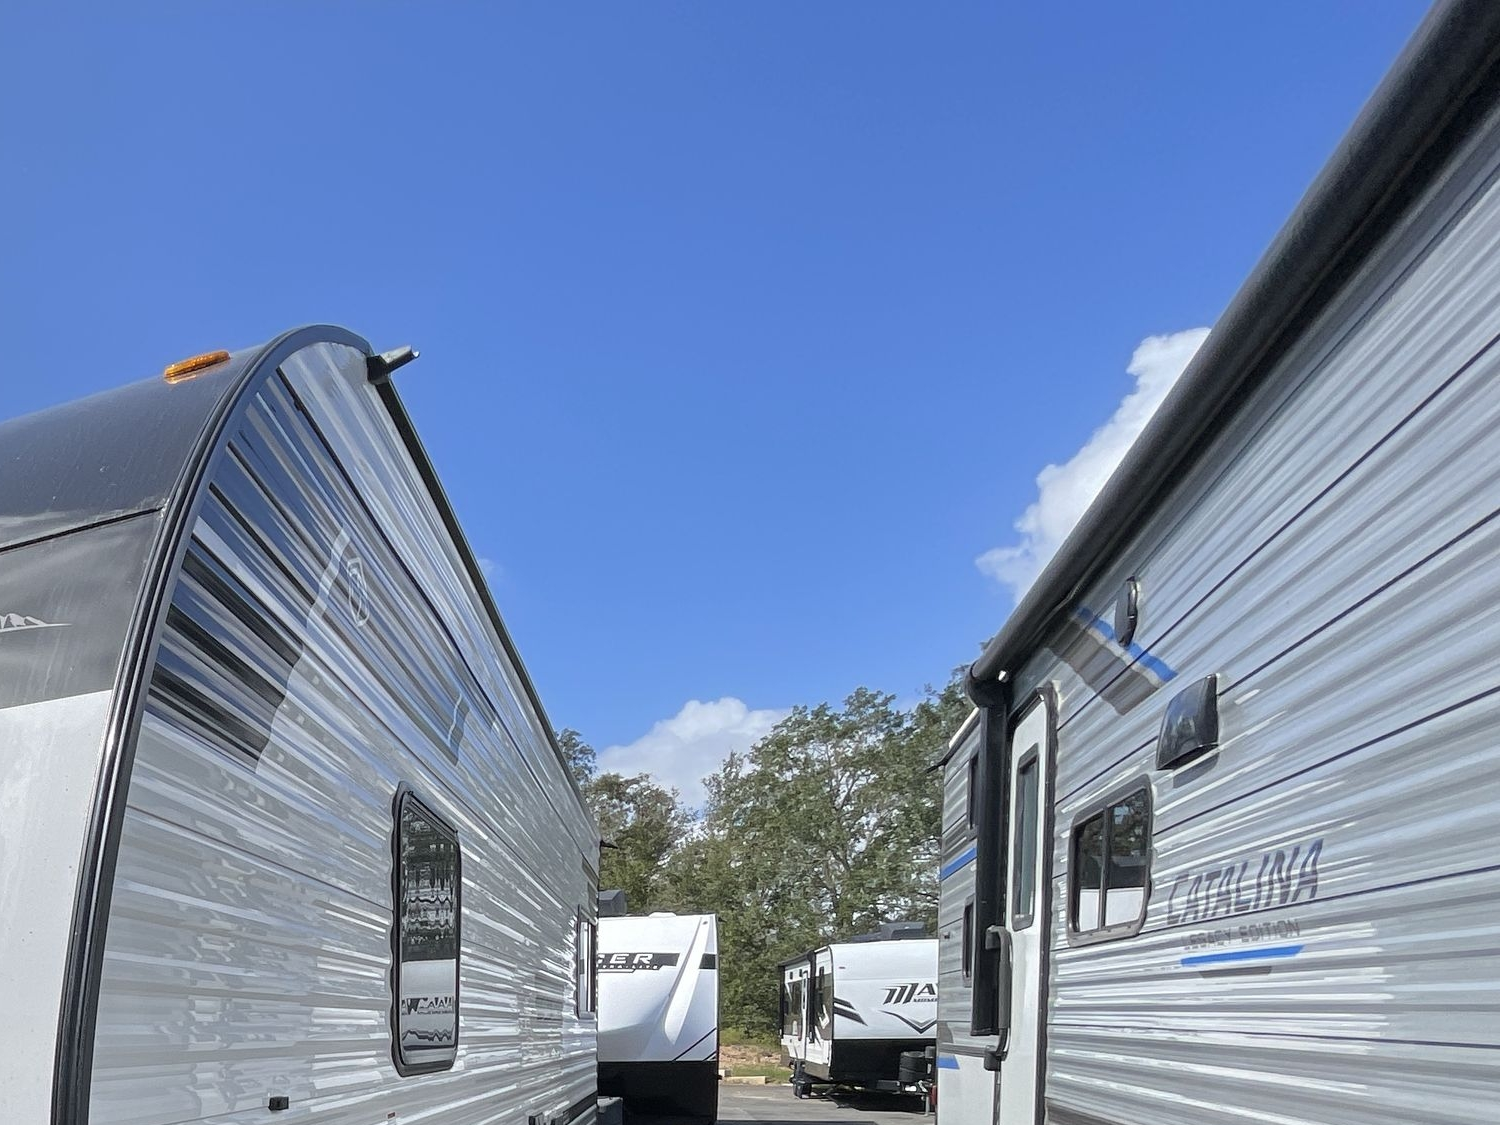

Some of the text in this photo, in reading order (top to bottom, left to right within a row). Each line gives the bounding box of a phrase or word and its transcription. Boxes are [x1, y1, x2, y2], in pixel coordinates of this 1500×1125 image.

[1167, 838, 1324, 925] CATALINA
[1238, 918, 1301, 943] EDITION
[880, 983, 939, 1005] MA
